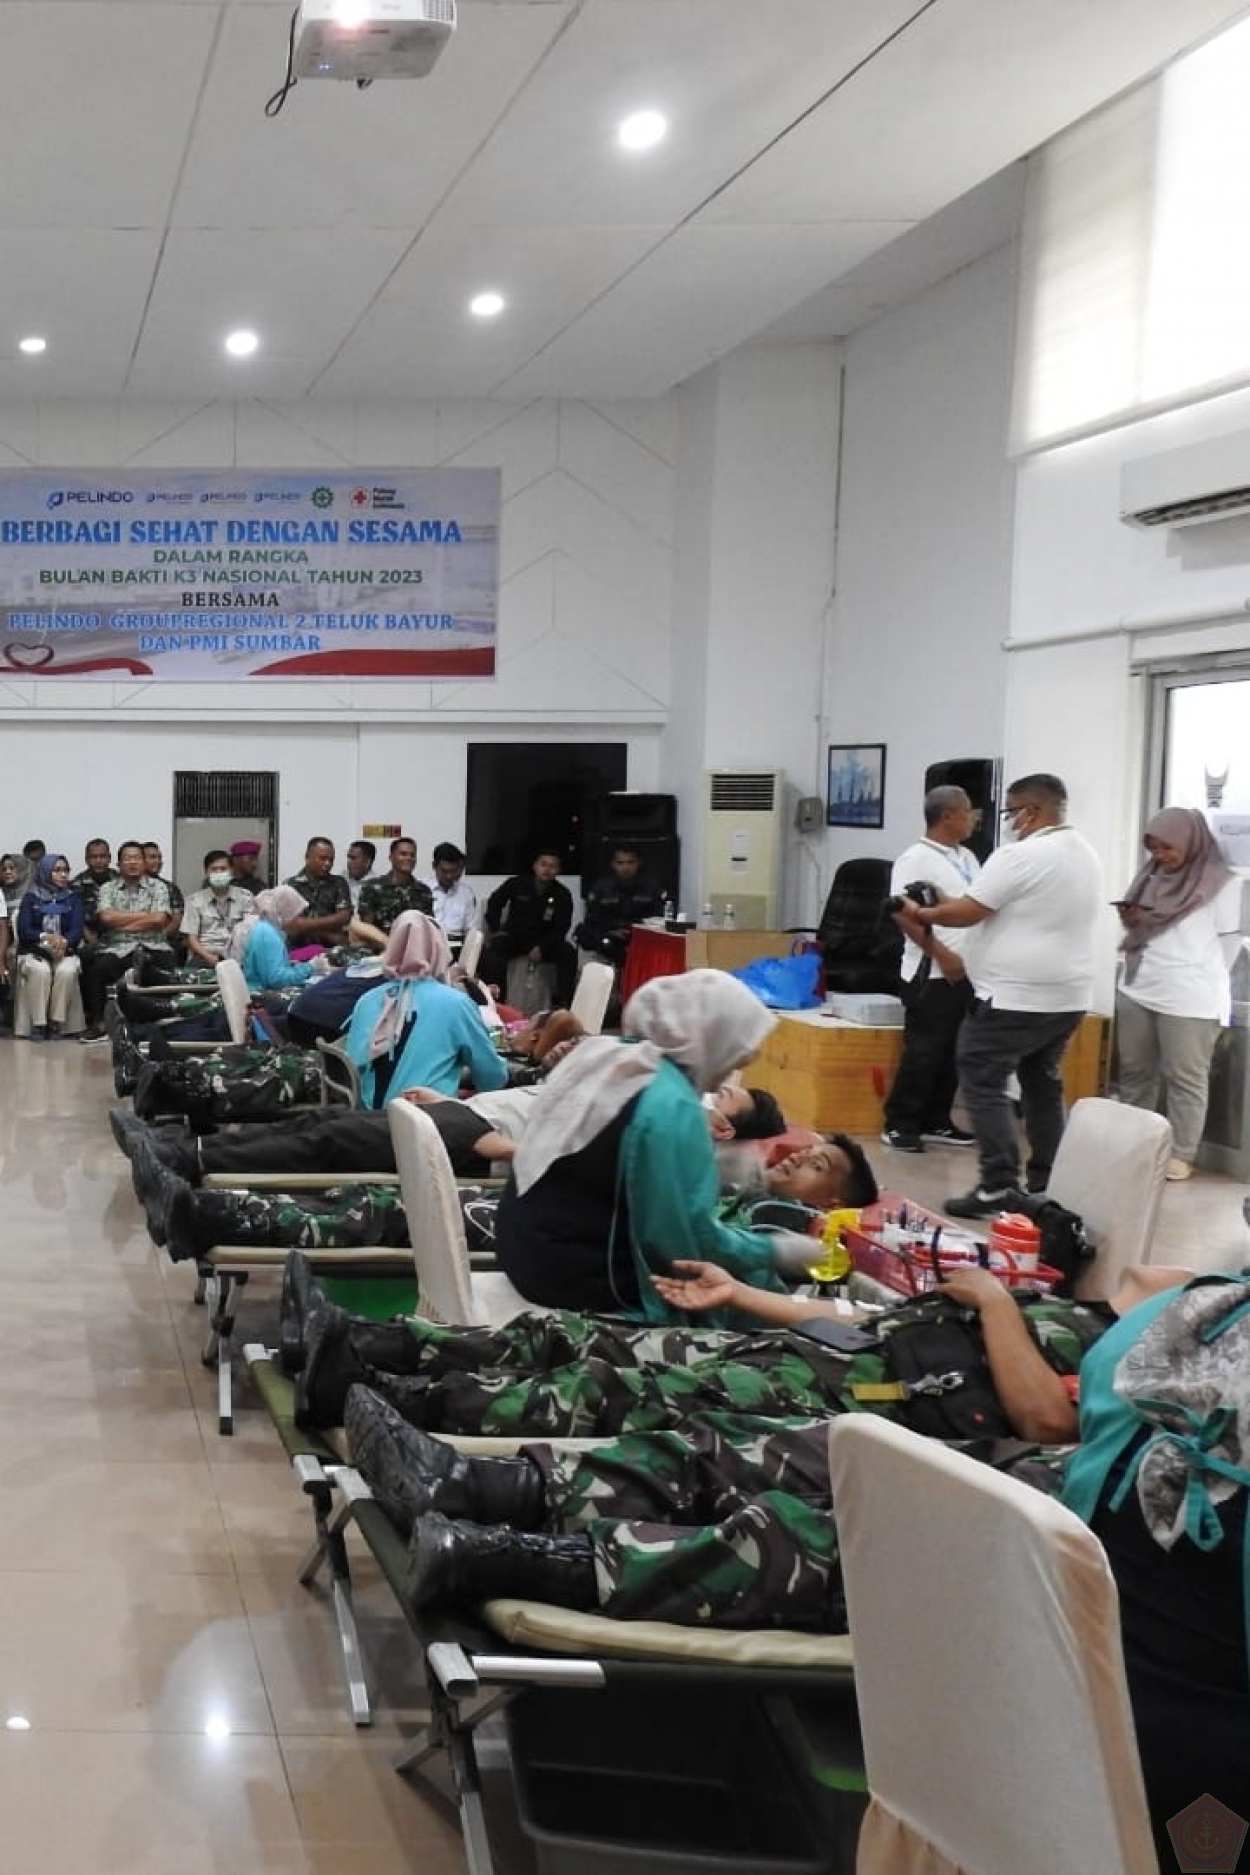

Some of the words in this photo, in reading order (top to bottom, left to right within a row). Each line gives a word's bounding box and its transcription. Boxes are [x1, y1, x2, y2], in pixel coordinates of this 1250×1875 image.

[67, 491, 134, 503] PELINDO
[1, 520, 121, 543] BERBAGI
[129, 520, 218, 543] SEHAT
[226, 520, 339, 543] DENGAN
[348, 520, 461, 543] SESAMA
[153, 549, 223, 564] DALAM
[228, 549, 309, 564] RANGKA
[39, 569, 105, 584] BULAN
[112, 569, 168, 584] BAKTI
[173, 569, 197, 584] K3
[202, 569, 301, 584] NASIONAL
[306, 569, 373, 584] TAHUN
[379, 569, 423, 584] 2023
[181, 591, 279, 607] BERSAMA
[9, 613, 100, 629] PELINDO
[294, 614, 307, 629] 2
[312, 614, 379, 630] TELUK
[384, 614, 453, 630] BAYUR
[139, 634, 182, 650] DAN
[189, 634, 229, 650] PMI
[233, 634, 321, 651] SUMBAR
